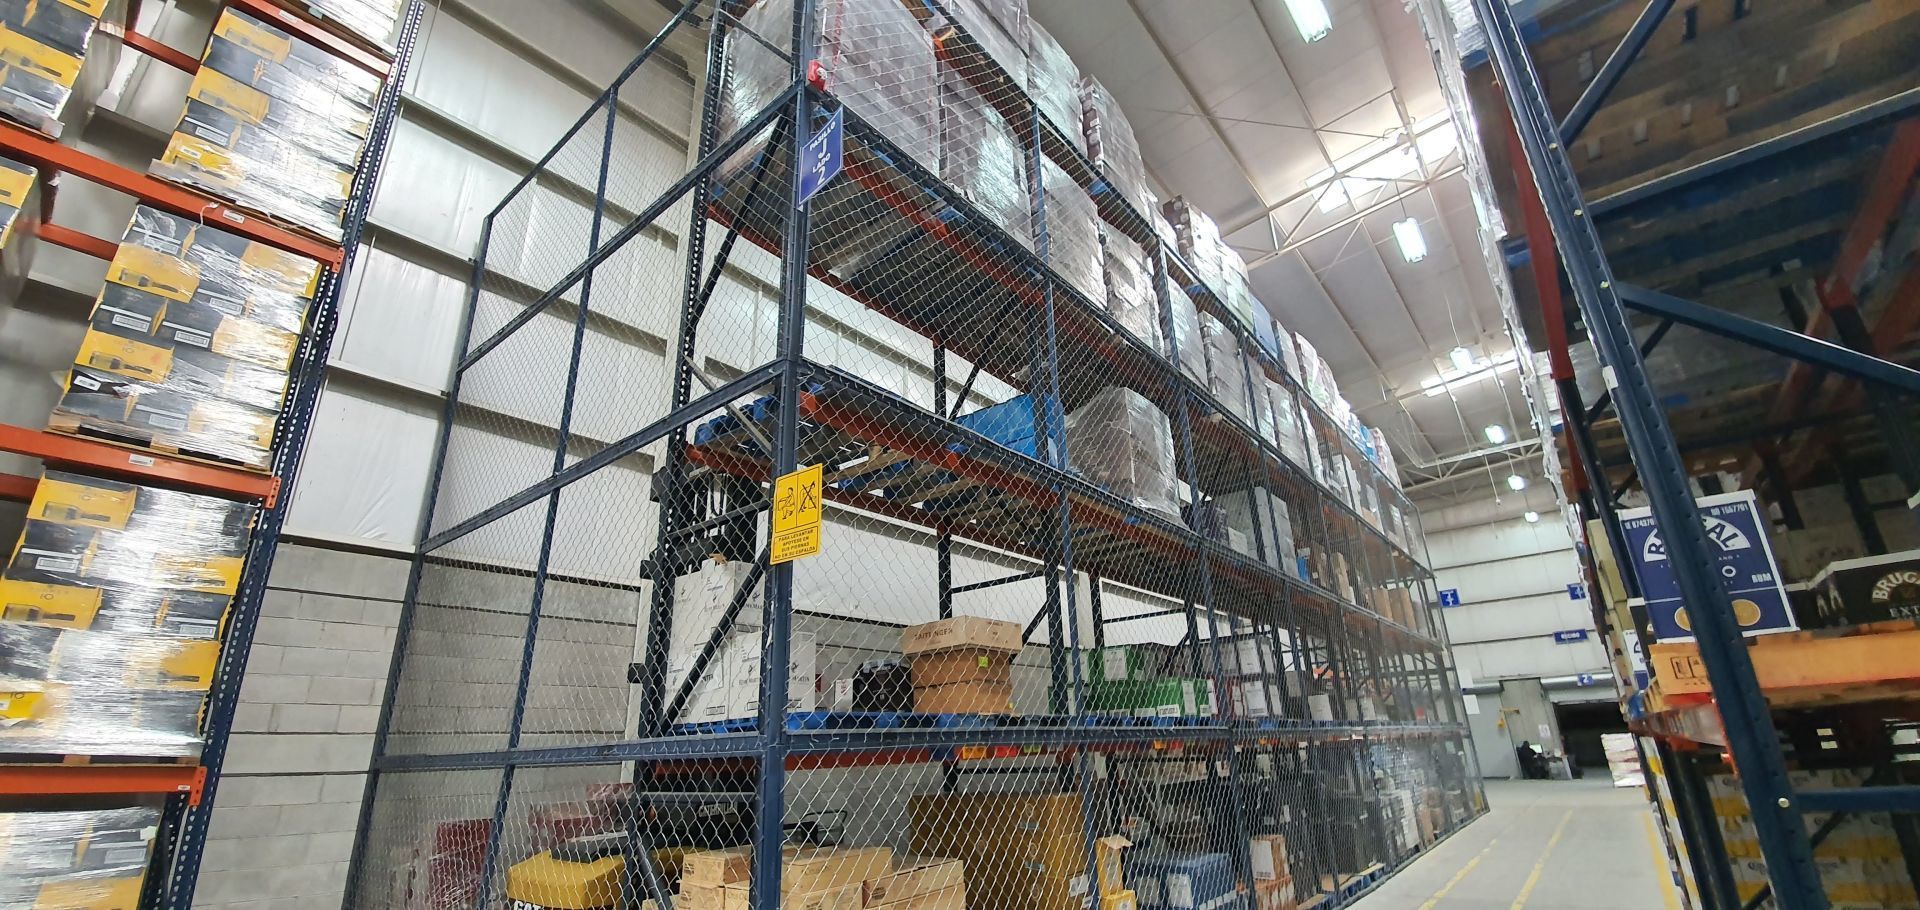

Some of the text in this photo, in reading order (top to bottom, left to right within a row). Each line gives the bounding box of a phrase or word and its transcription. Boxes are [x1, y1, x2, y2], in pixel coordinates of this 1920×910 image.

[809, 121, 836, 151] PASILLO
[818, 138, 828, 160] J
[812, 153, 831, 173] LADO
[817, 165, 826, 186] 2
[791, 529, 813, 538] LEVANTAR
[1872, 571, 1920, 601] BRUG
[914, 628, 953, 641] TAITTNGER
